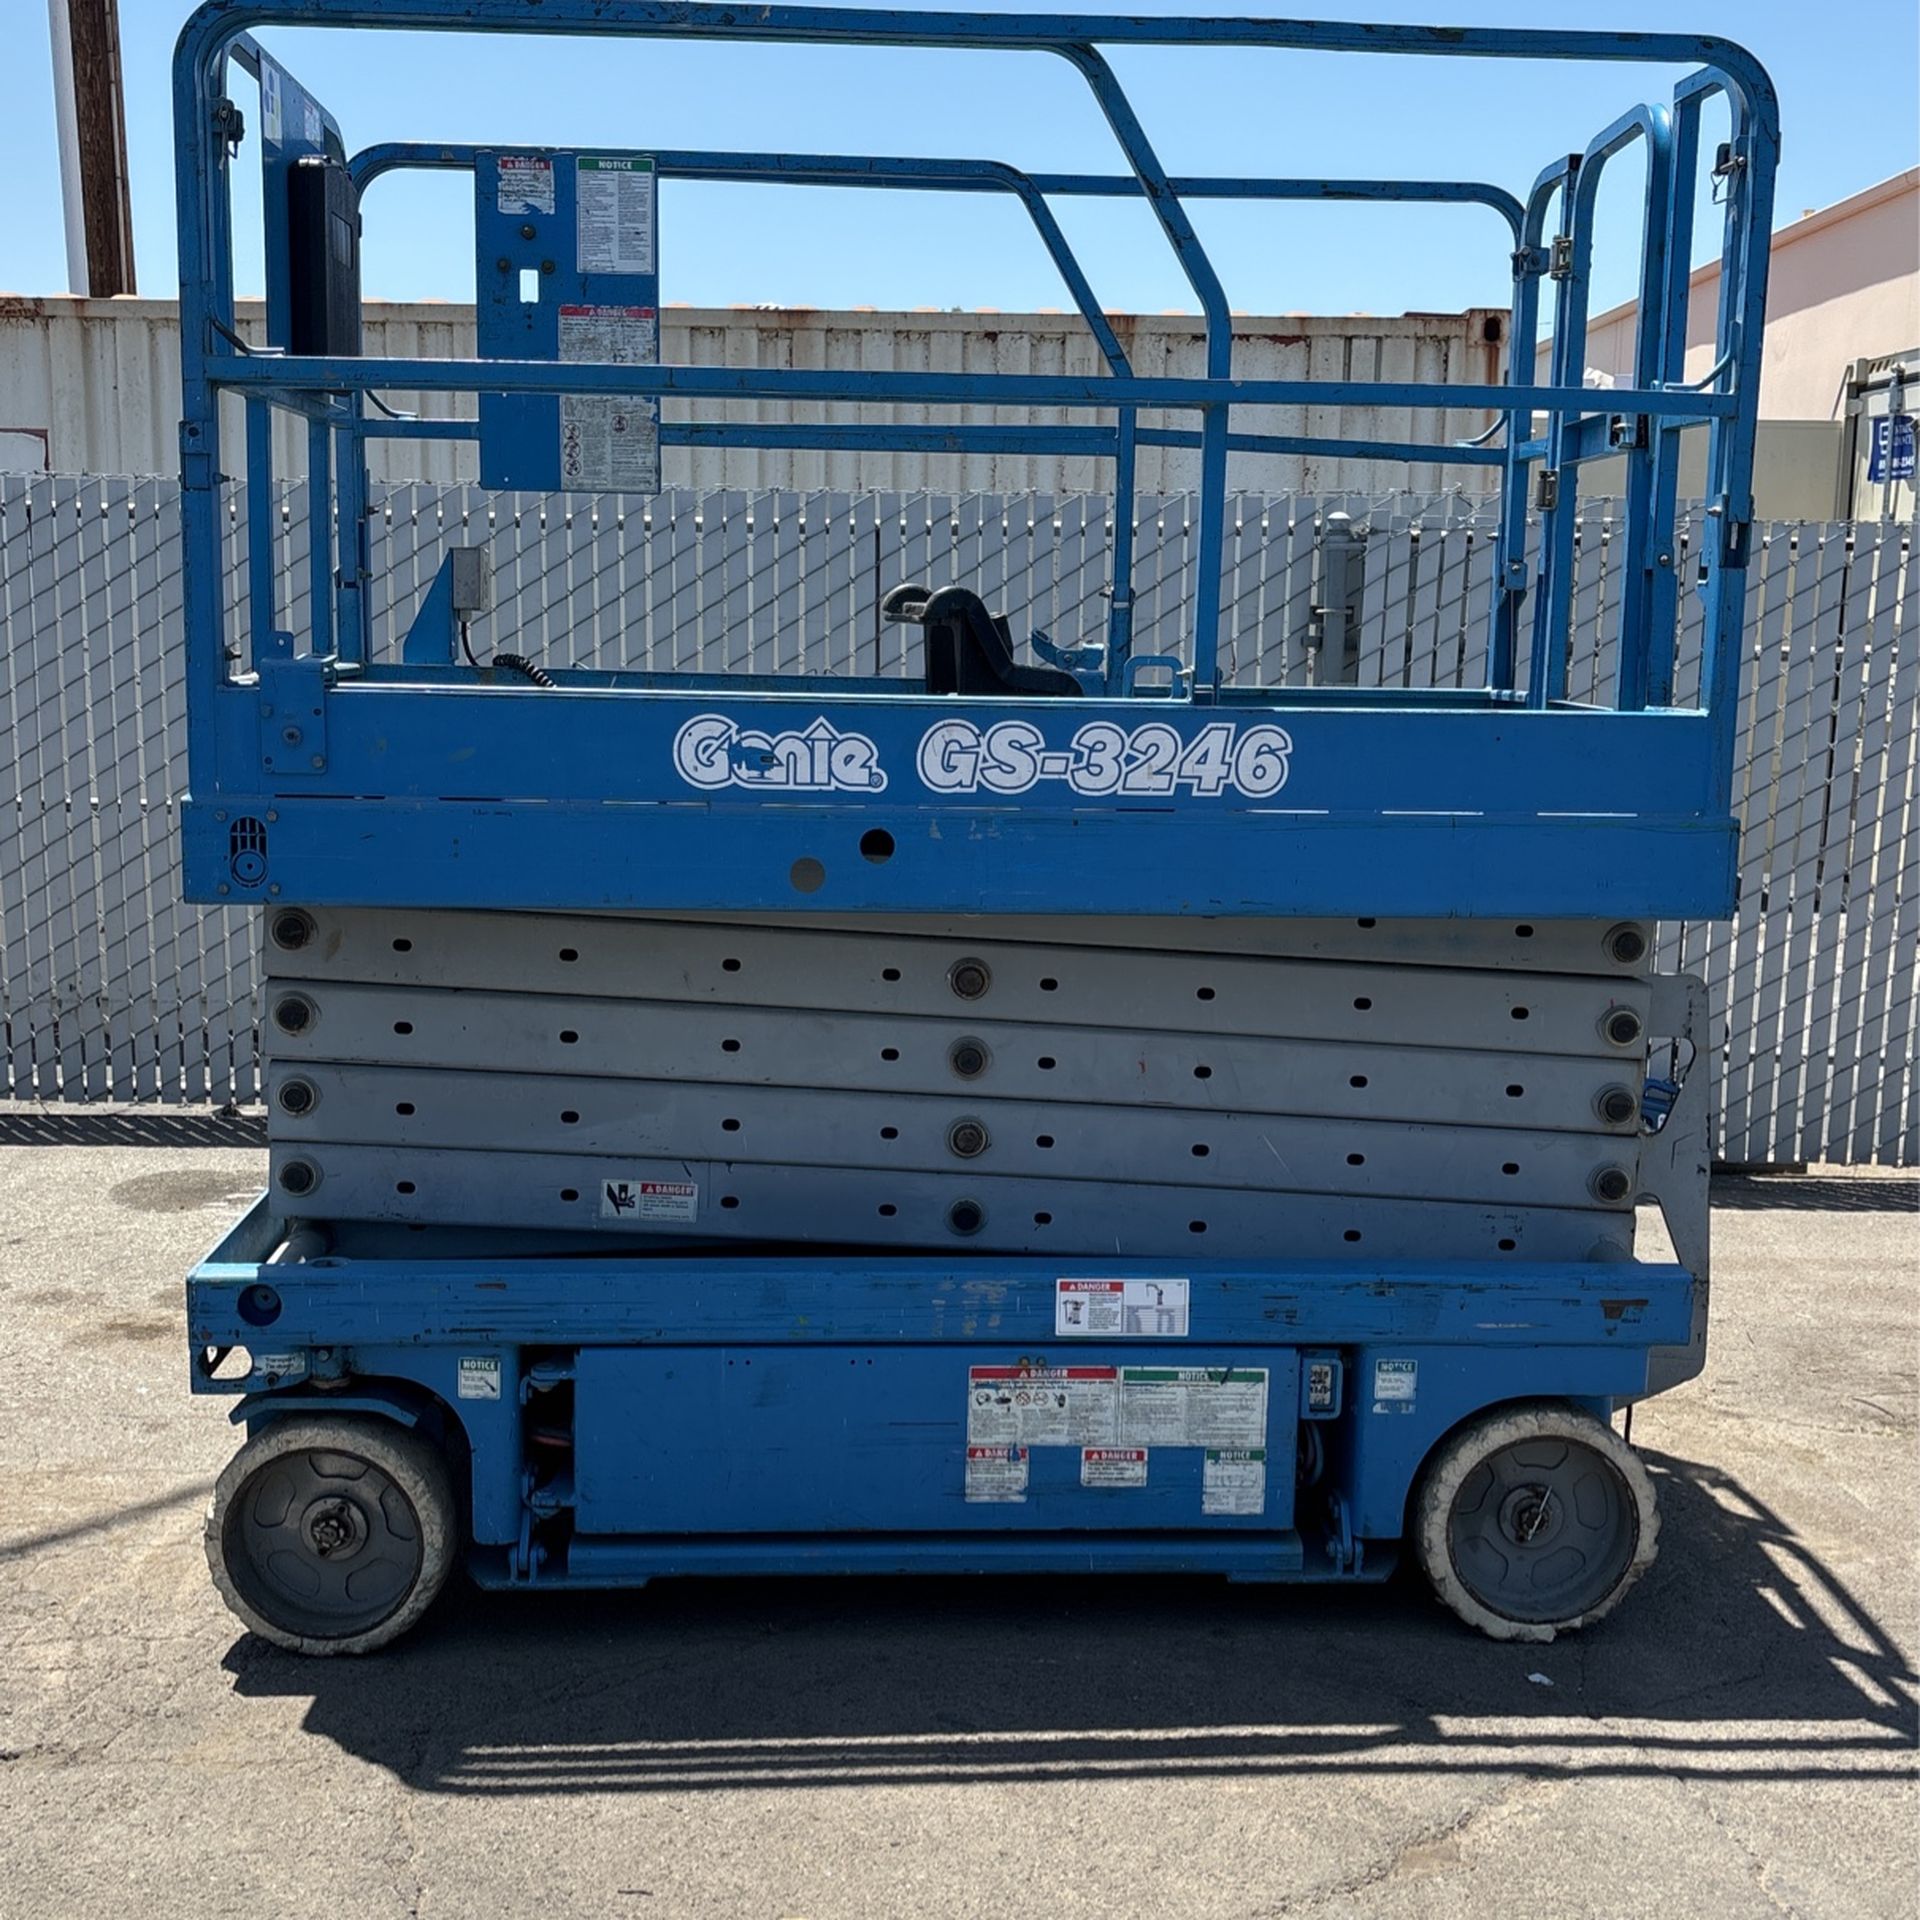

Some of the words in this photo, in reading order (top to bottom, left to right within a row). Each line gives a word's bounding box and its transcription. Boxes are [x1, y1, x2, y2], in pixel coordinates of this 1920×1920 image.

[599, 160, 632, 170] NOTICE
[916, 718, 1293, 799] GS-3246
[656, 1185, 692, 1195] DANGER
[1077, 1283, 1111, 1291] DANGER
[463, 1360, 496, 1370] NOTICE
[1030, 1369, 1068, 1378] DANGER
[1101, 1451, 1138, 1460] DANGER
[1220, 1451, 1251, 1460] NOTICE
